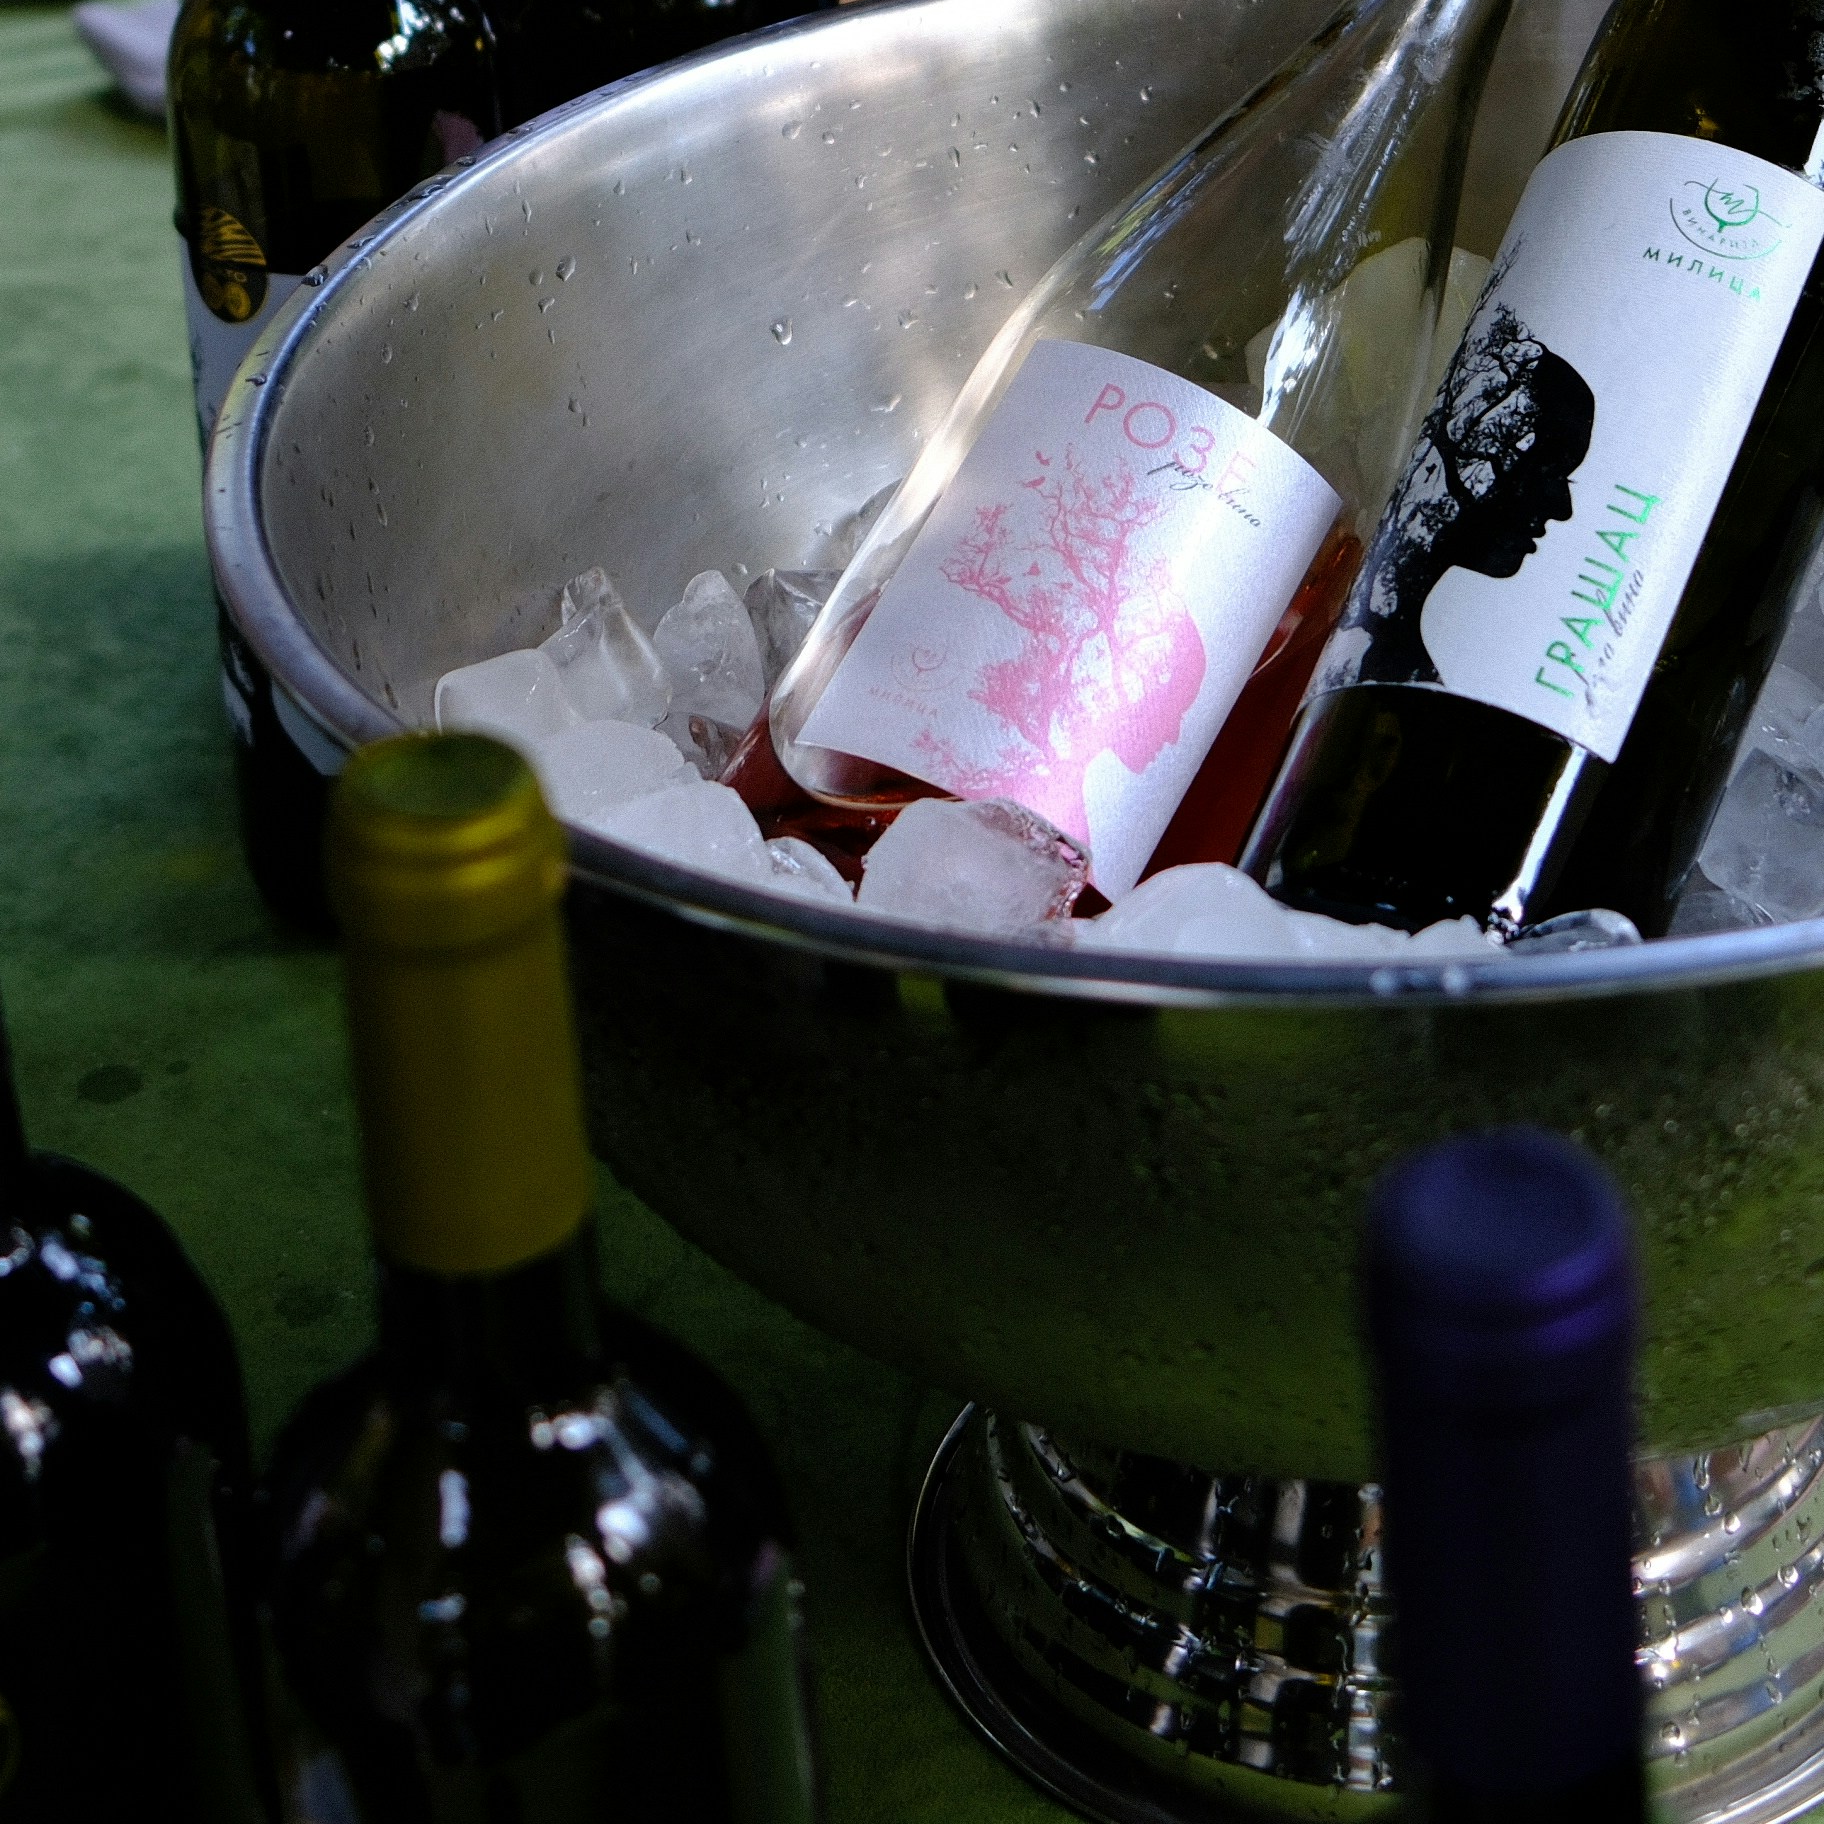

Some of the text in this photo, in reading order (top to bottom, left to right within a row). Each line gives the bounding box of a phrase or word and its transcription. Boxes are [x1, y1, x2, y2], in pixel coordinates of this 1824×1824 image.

[1642, 246, 1762, 302] МИЛИЦА
[1084, 382, 1258, 498] РОЗЕ
[1535, 483, 1663, 699] ГРАШАЦ
